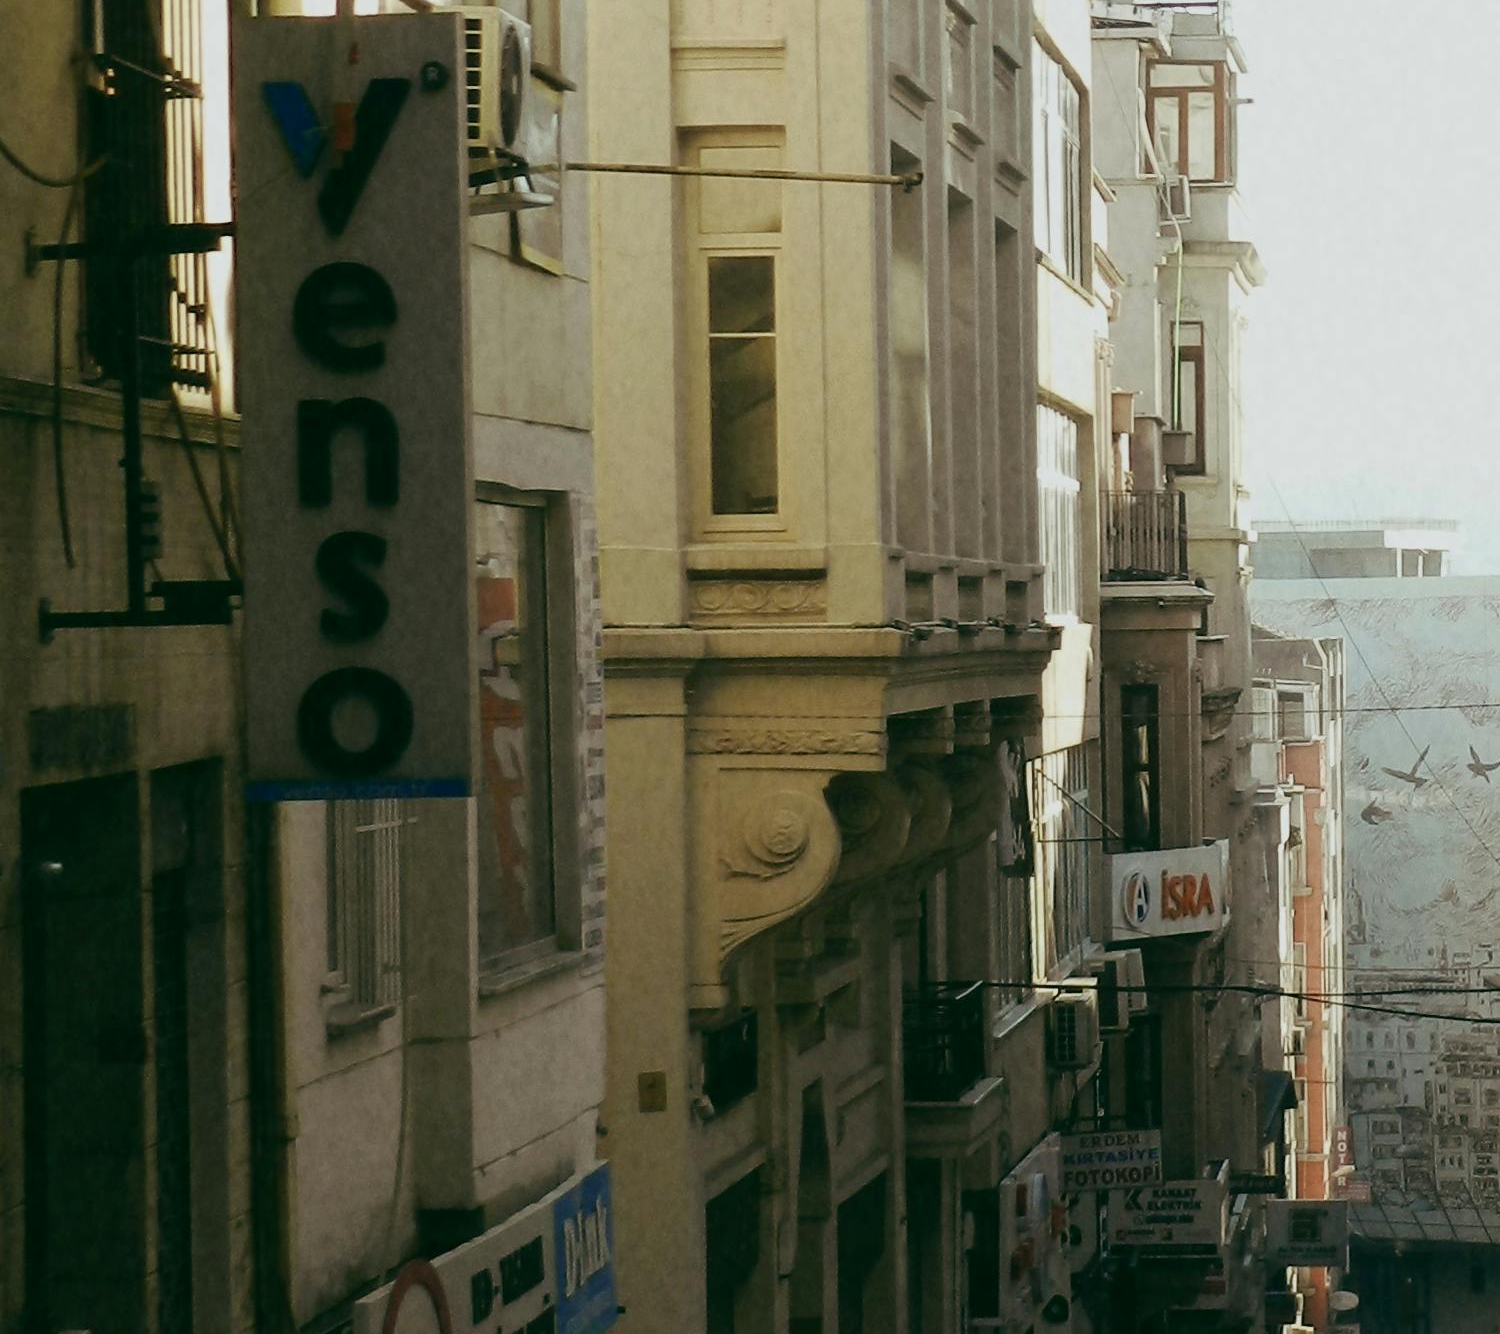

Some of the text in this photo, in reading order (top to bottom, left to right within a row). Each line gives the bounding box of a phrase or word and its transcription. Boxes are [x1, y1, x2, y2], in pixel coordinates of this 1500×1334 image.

[1161, 869, 1215, 920] İSRA
[1080, 1133, 1140, 1149] ERDEM
[1064, 1148, 1158, 1163] KIRTASİYE
[1337, 1130, 1347, 1187] NOTR
[1064, 1162, 1161, 1186] FOTOKOPİ
